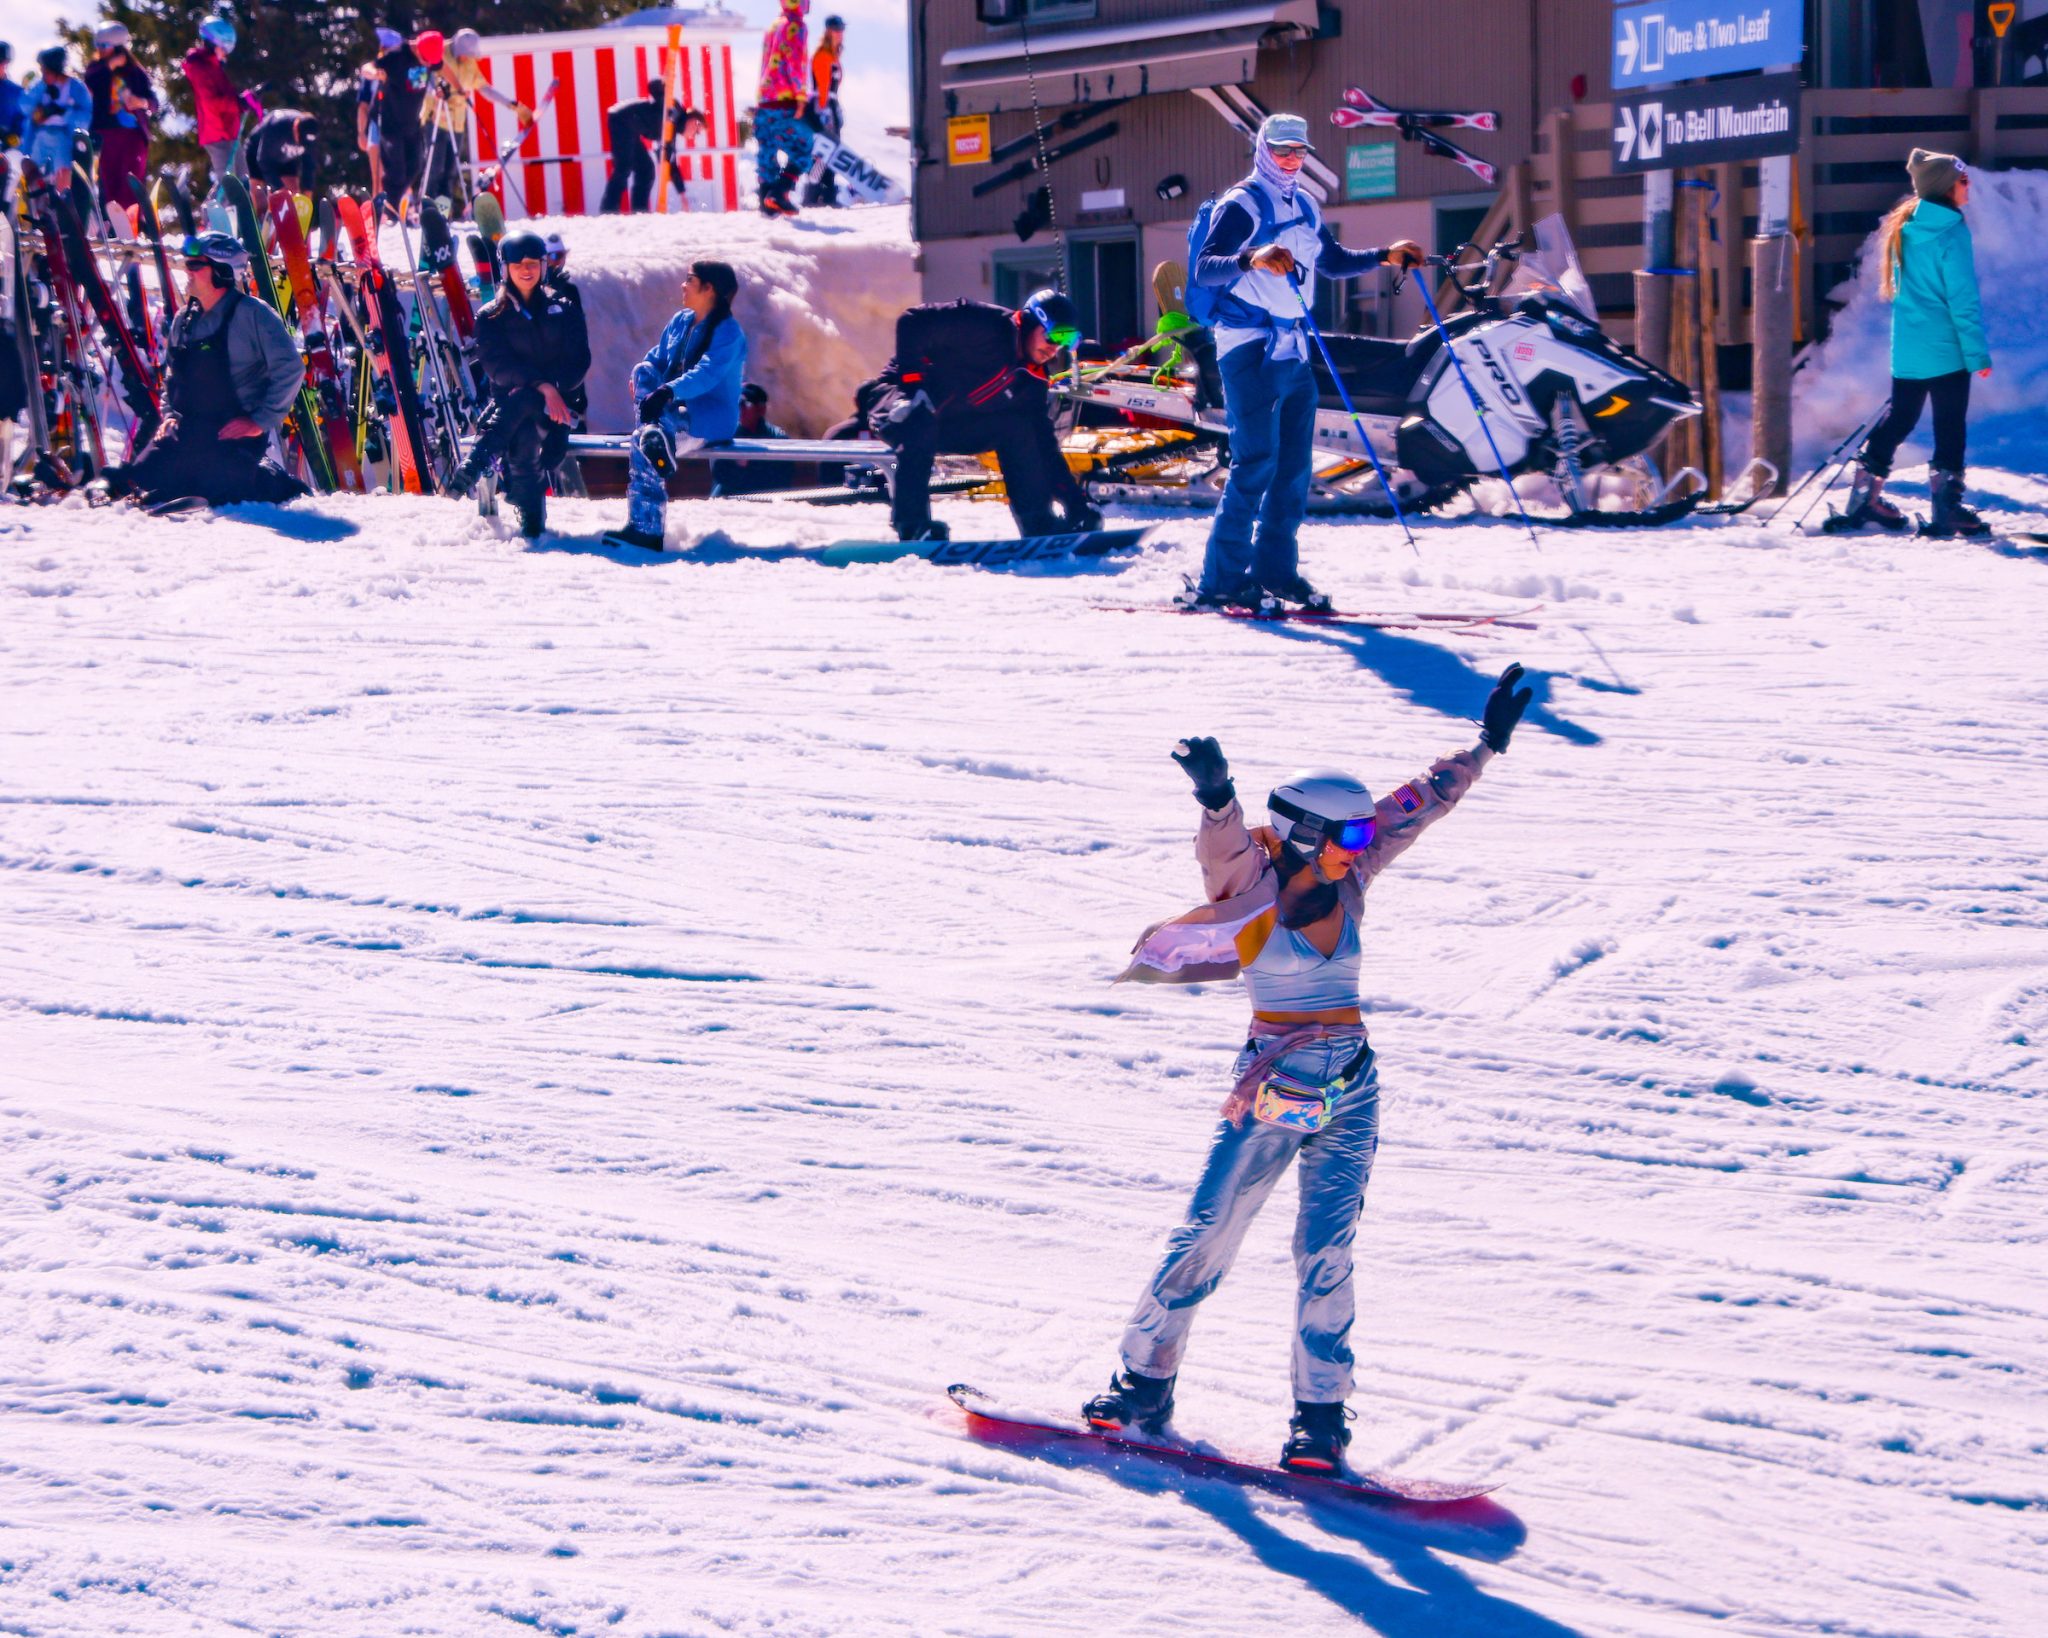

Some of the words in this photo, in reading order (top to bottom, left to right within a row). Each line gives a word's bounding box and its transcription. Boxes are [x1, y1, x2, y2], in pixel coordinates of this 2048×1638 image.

[1665, 26, 1693, 55] One
[1694, 21, 1708, 51] &
[1707, 18, 1737, 48] Two
[1738, 8, 1771, 44] Leaf
[1665, 112, 1684, 144] To
[1685, 108, 1716, 142] Bell
[1716, 99, 1790, 138] Mountain
[1469, 339, 1521, 405] PRO
